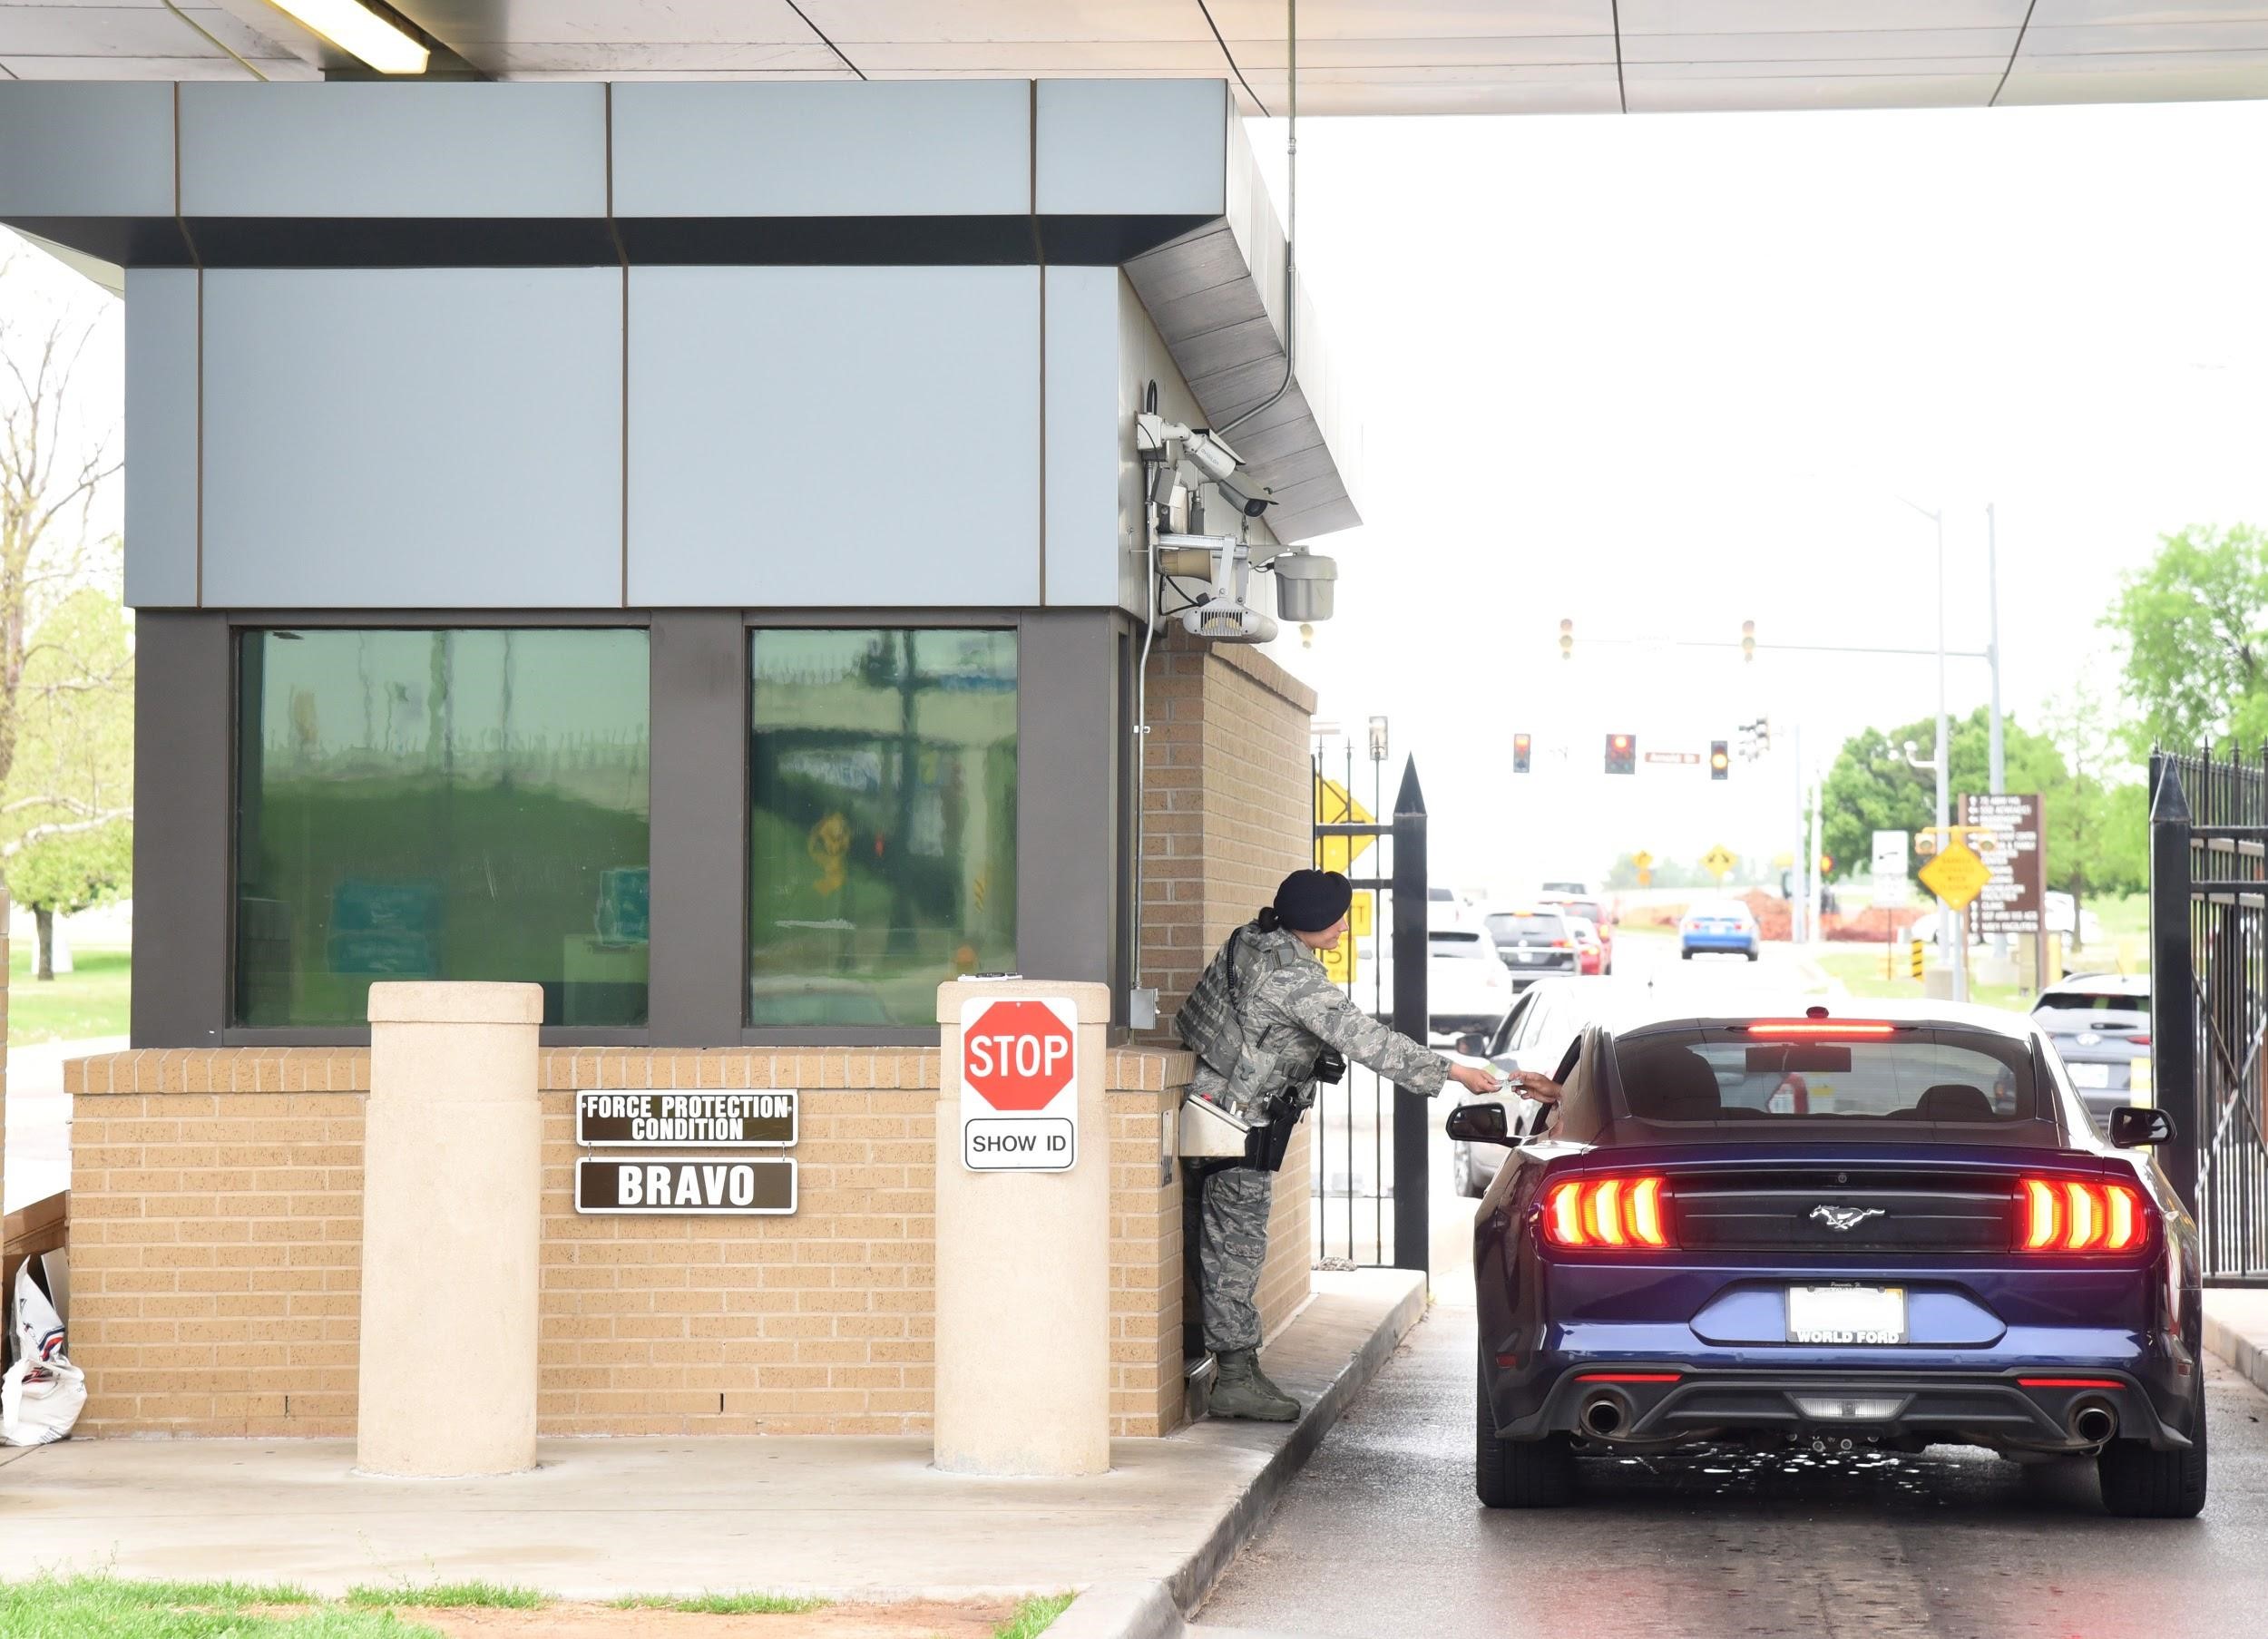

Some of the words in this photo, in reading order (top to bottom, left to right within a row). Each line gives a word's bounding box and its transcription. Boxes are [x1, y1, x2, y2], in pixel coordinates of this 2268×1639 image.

[969, 1034, 1069, 1078] STOP
[587, 1096, 651, 1118] FORCE
[661, 1096, 788, 1118] PROTECTION
[631, 1117, 744, 1140] CONDITION
[973, 1135, 1037, 1153] SHOW
[1047, 1135, 1067, 1151] ID
[618, 1165, 755, 1206] BRAVO
[1796, 1330, 1853, 1343] WORLD
[1856, 1330, 1900, 1344] FORD
